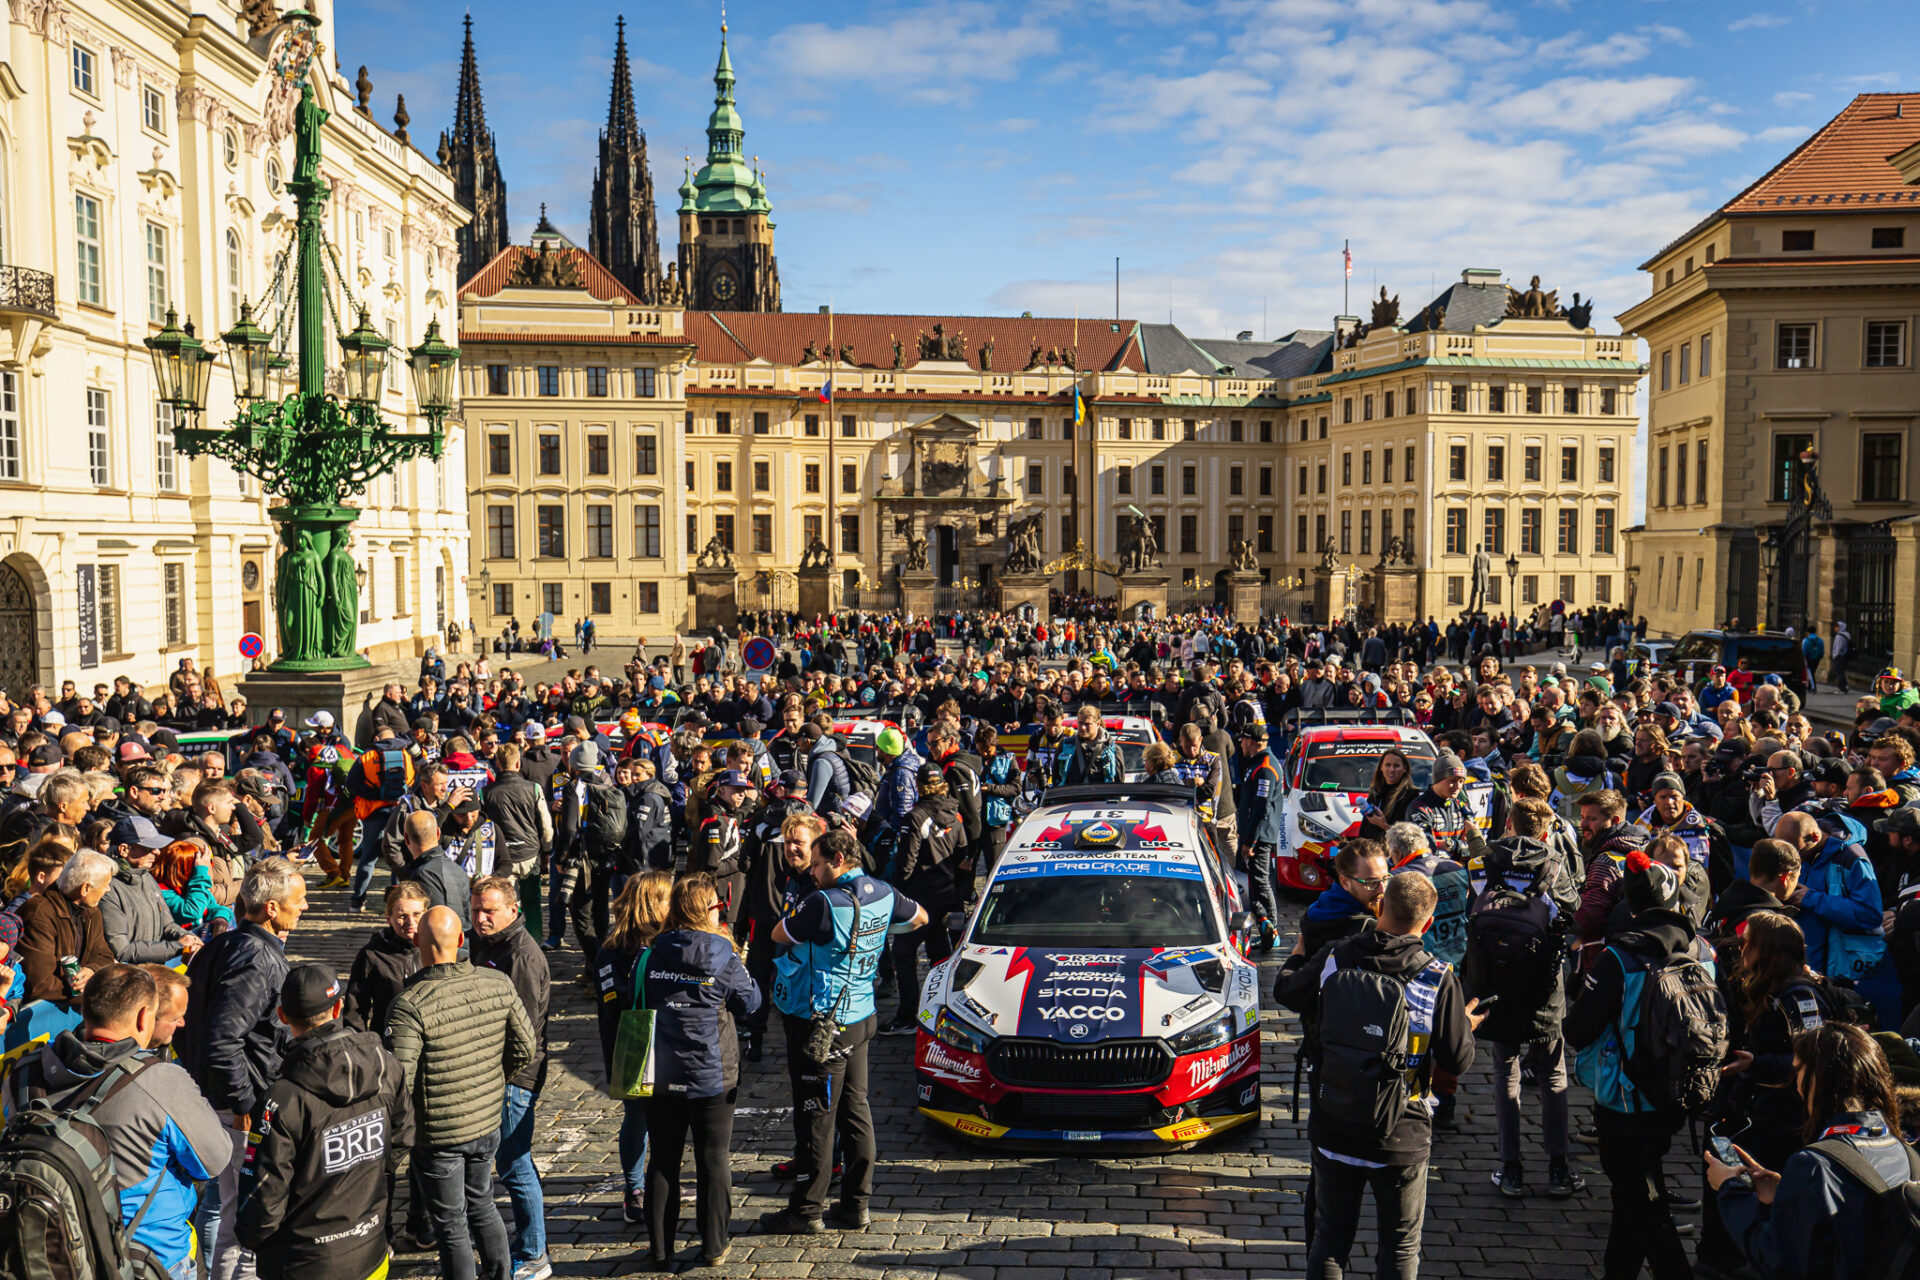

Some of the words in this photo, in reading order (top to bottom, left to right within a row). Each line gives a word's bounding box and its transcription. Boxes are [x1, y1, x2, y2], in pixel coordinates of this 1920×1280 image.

[1019, 841, 1062, 849] LKQ
[1124, 852, 1158, 860] TEAM
[860, 913, 889, 931] WRC
[1431, 919, 1460, 941] 197
[1037, 1005, 1126, 1021] YACCO
[925, 1040, 982, 1079] Milwaukee
[1186, 1040, 1252, 1088] Milwaukee
[323, 1110, 383, 1137] www.brr.at
[955, 1118, 993, 1137] PIRELLI
[324, 1120, 385, 1166] BRR
